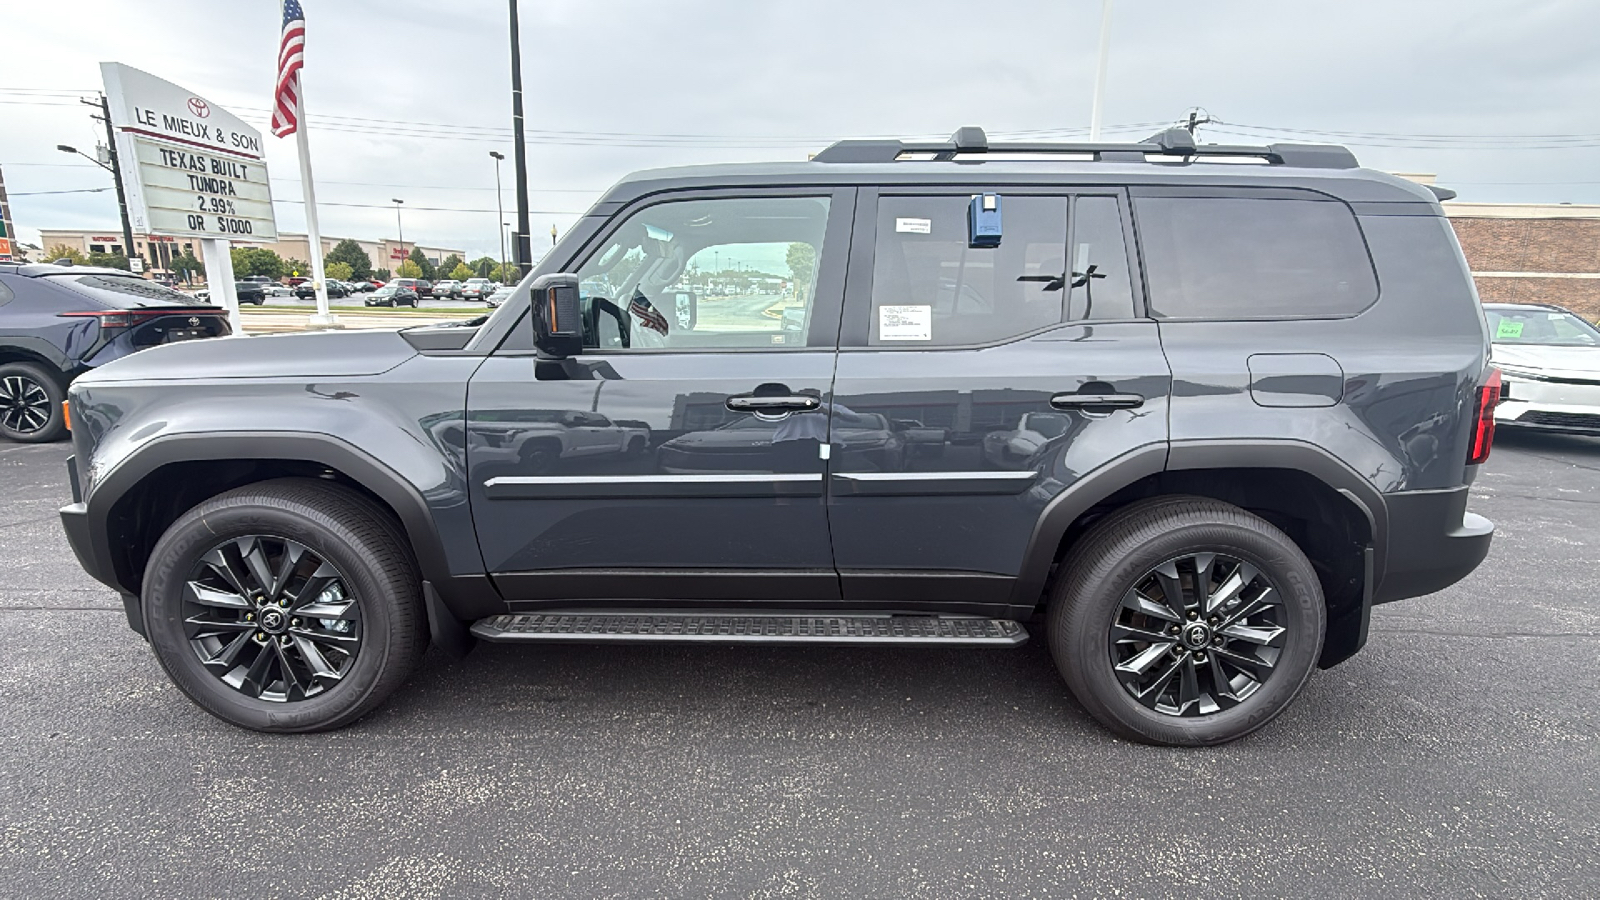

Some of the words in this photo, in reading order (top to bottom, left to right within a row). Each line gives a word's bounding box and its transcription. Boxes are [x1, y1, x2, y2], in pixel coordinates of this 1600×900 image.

[135, 107, 157, 127] LE
[163, 115, 210, 140] MIEUX
[216, 128, 226, 144] &
[231, 133, 259, 151] SON
[160, 148, 207, 173] TEXAS
[211, 158, 248, 179] BUILT
[187, 174, 237, 196] TUNDRA
[197, 195, 236, 215] 2.99%
[188, 214, 206, 231] OR
